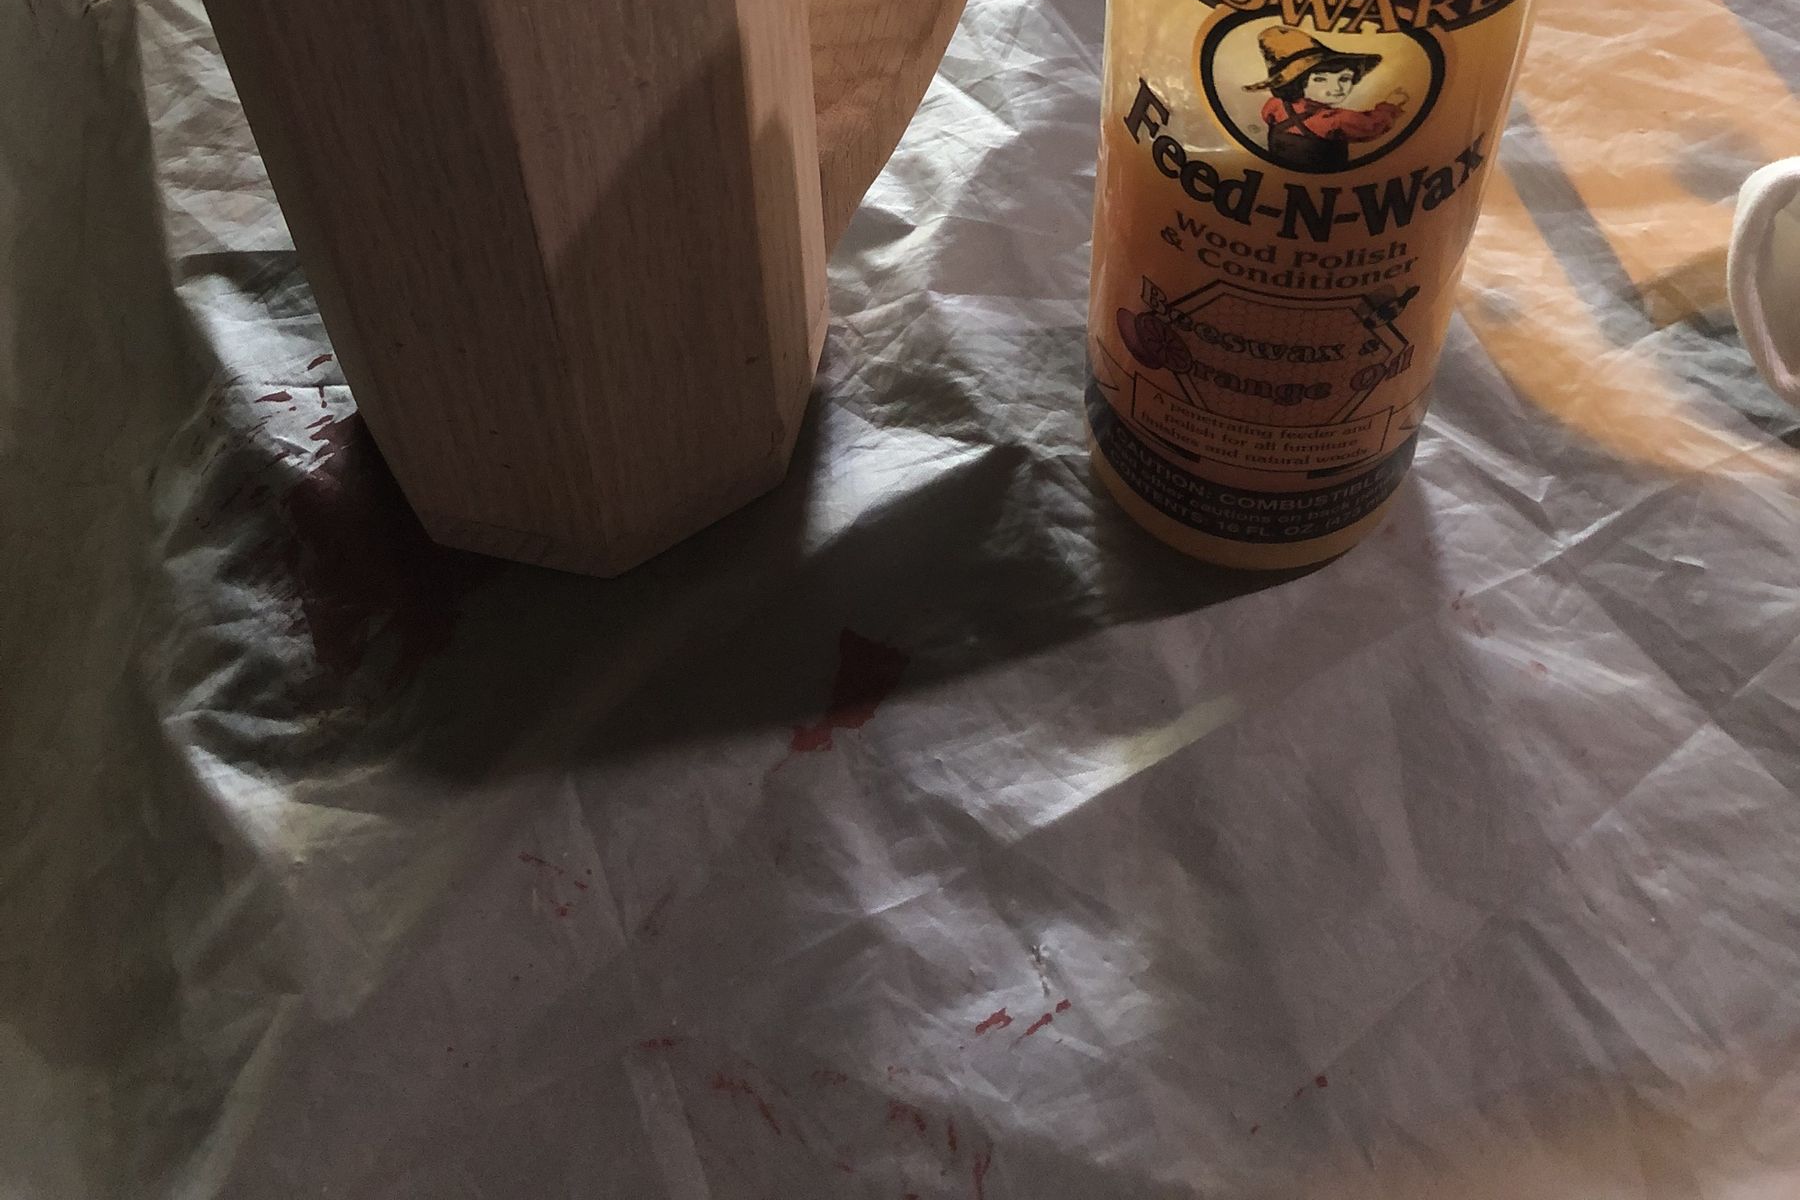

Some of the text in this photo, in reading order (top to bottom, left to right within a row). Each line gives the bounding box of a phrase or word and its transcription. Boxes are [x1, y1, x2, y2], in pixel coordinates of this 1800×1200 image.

[1123, 77, 1486, 242] Feed-N-Wax
[1175, 210, 1408, 270] Wood Polish
[1197, 247, 1419, 290] Conditioner
[1141, 275, 1347, 363] Beeswax
[1350, 345, 1415, 391] Oil
[1164, 413, 1216, 440] polish
[1221, 434, 1249, 448] for
[1169, 403, 1274, 439] penetrating
[1280, 428, 1336, 440] feeder
[1342, 418, 1373, 435] and
[1204, 443, 1239, 459] and
[1244, 452, 1311, 465] natural
[1277, 513, 1302, 525] on
